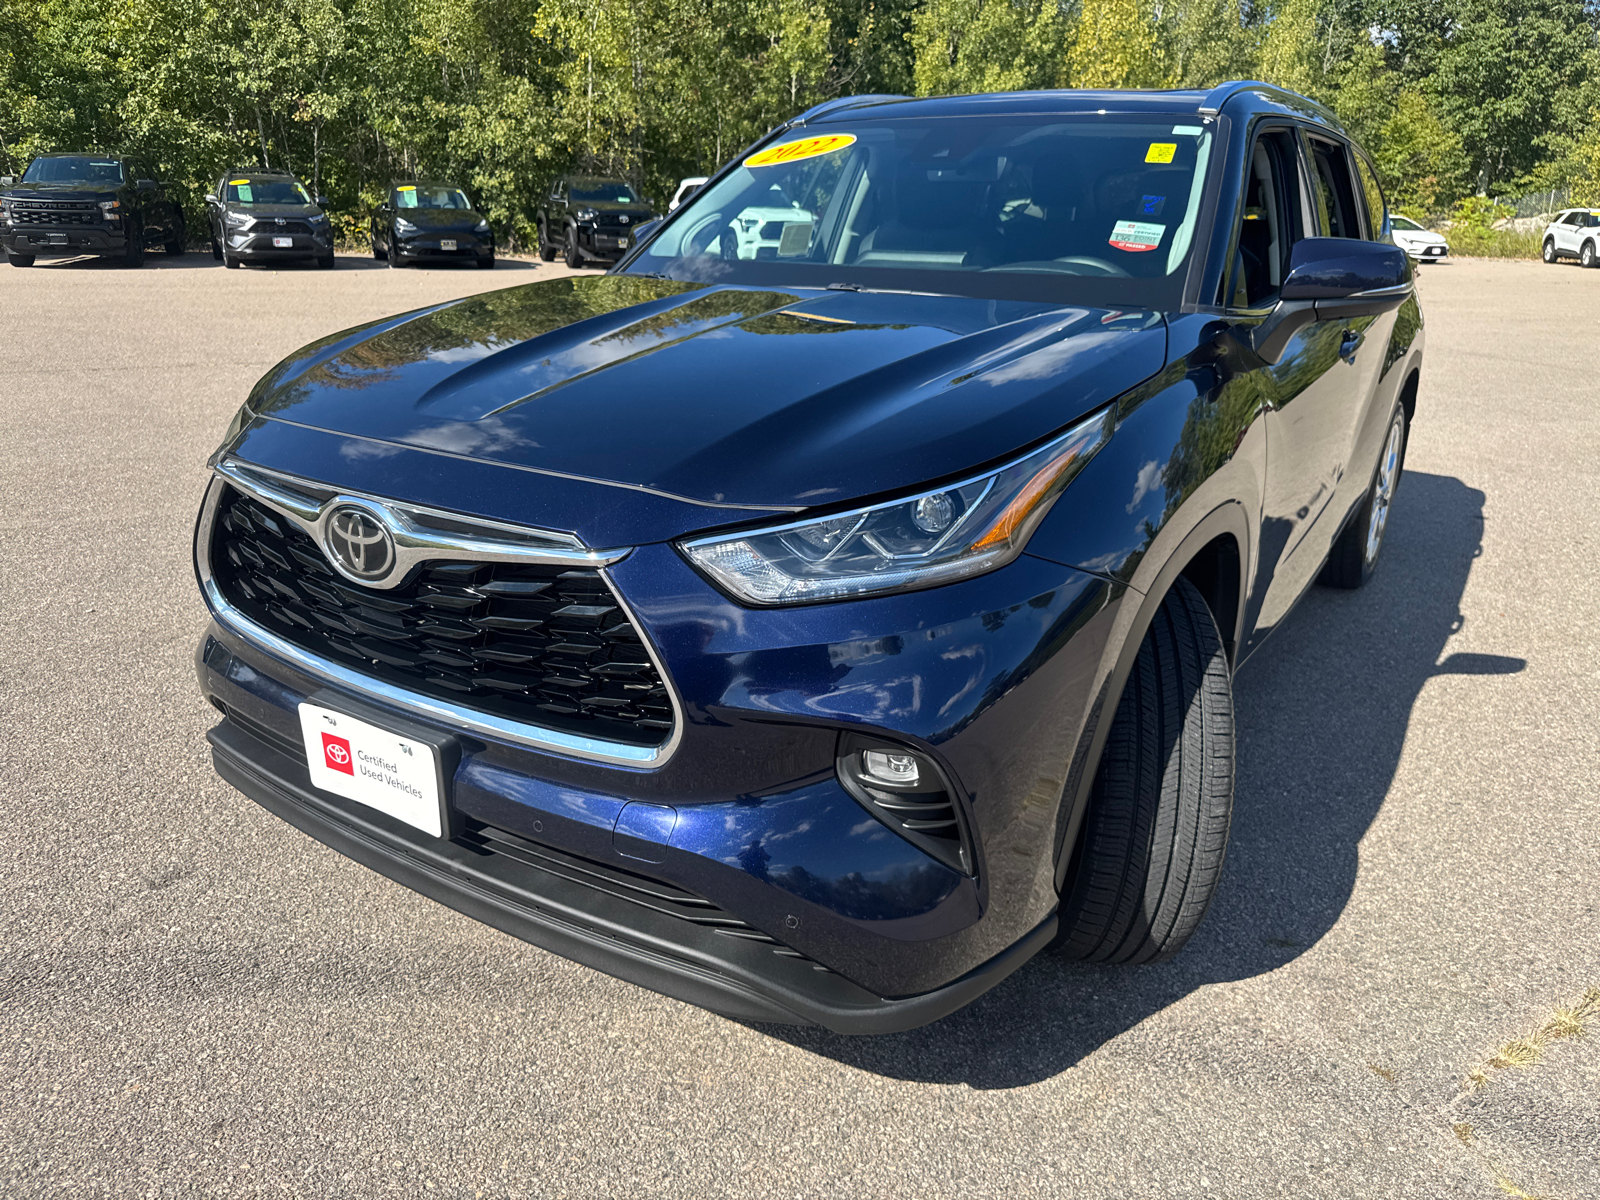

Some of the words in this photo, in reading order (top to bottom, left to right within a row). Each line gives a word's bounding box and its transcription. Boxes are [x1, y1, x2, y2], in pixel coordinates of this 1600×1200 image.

[756, 138, 838, 164] 2022
[14, 201, 92, 209] CHEVROLET
[357, 749, 397, 774] Certified
[360, 764, 383, 783] Used
[385, 774, 423, 799] Vehicles
